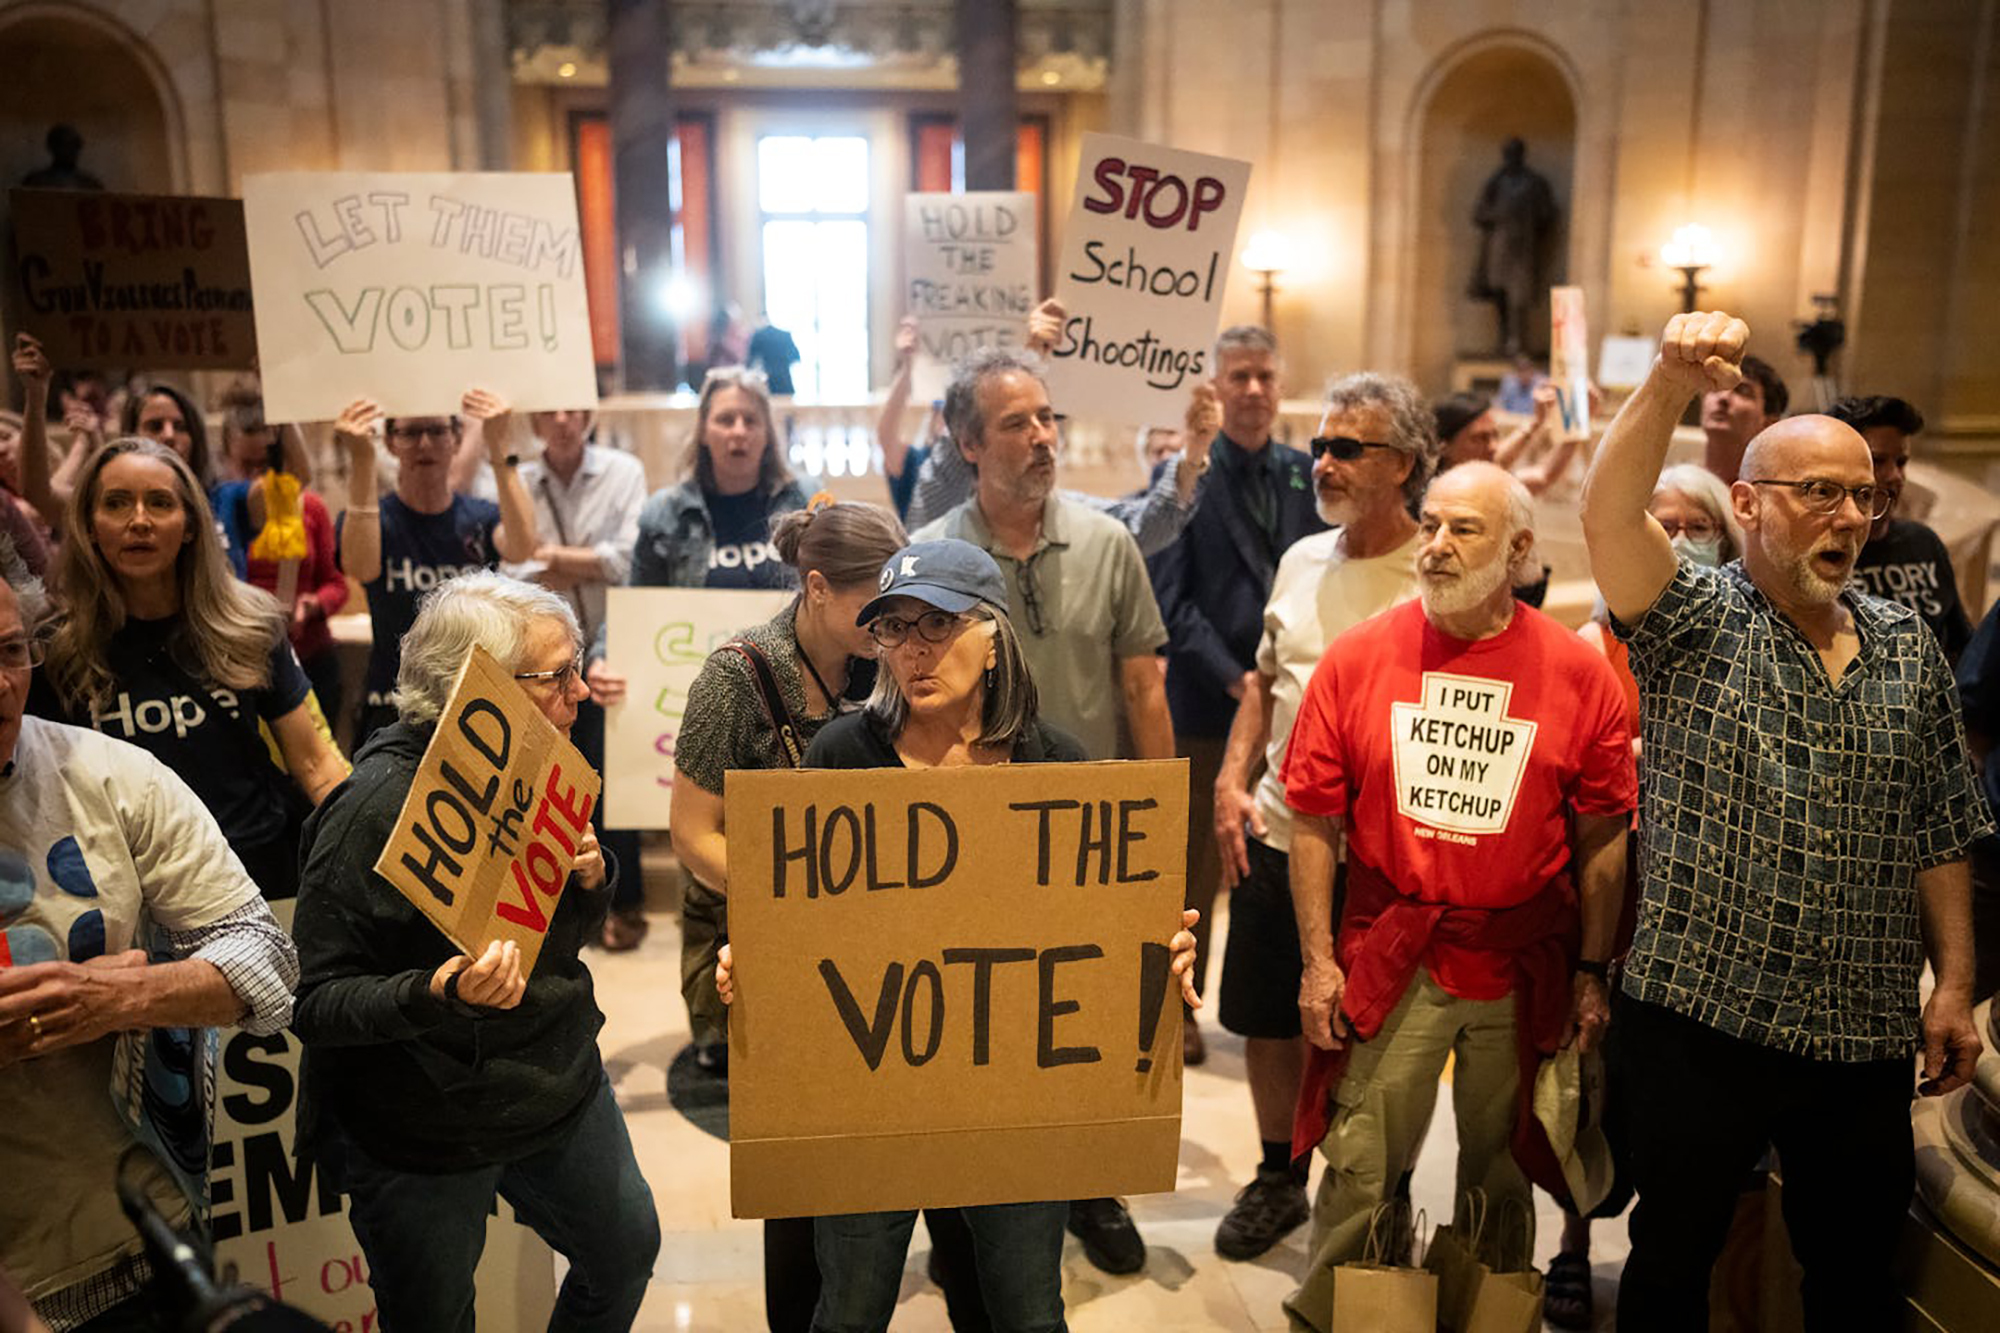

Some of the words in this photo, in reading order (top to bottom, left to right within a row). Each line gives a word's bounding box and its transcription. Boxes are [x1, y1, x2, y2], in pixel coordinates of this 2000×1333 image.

[920, 204, 1018, 240] HOLD
[1083, 157, 1226, 232] STOP
[79, 198, 215, 255] BRING
[295, 193, 409, 269] LET
[429, 195, 582, 280] THEM
[939, 245, 995, 271] THE
[1070, 241, 1219, 301] School
[303, 283, 559, 354] VOTE!
[911, 278, 1030, 314] FREAKING
[70, 316, 112, 356] TO
[122, 320, 146, 356] A
[153, 317, 229, 356] VOTE
[1053, 317, 1206, 389] Shootings
[1440, 687, 1447, 707] I
[1452, 689, 1495, 713] PUT
[1410, 717, 1515, 755] KETCHUP
[1427, 754, 1455, 778] ON
[1460, 759, 1489, 783] MY
[401, 698, 512, 907] HOLD
[488, 778, 534, 858] the
[1409, 786, 1502, 819] KETCHUP
[496, 763, 592, 933] VOTE
[772, 801, 959, 899] HOLD
[1009, 798, 1160, 887] THE
[1414, 827, 1435, 839] NEW
[818, 942, 1172, 1074] VOTE!
